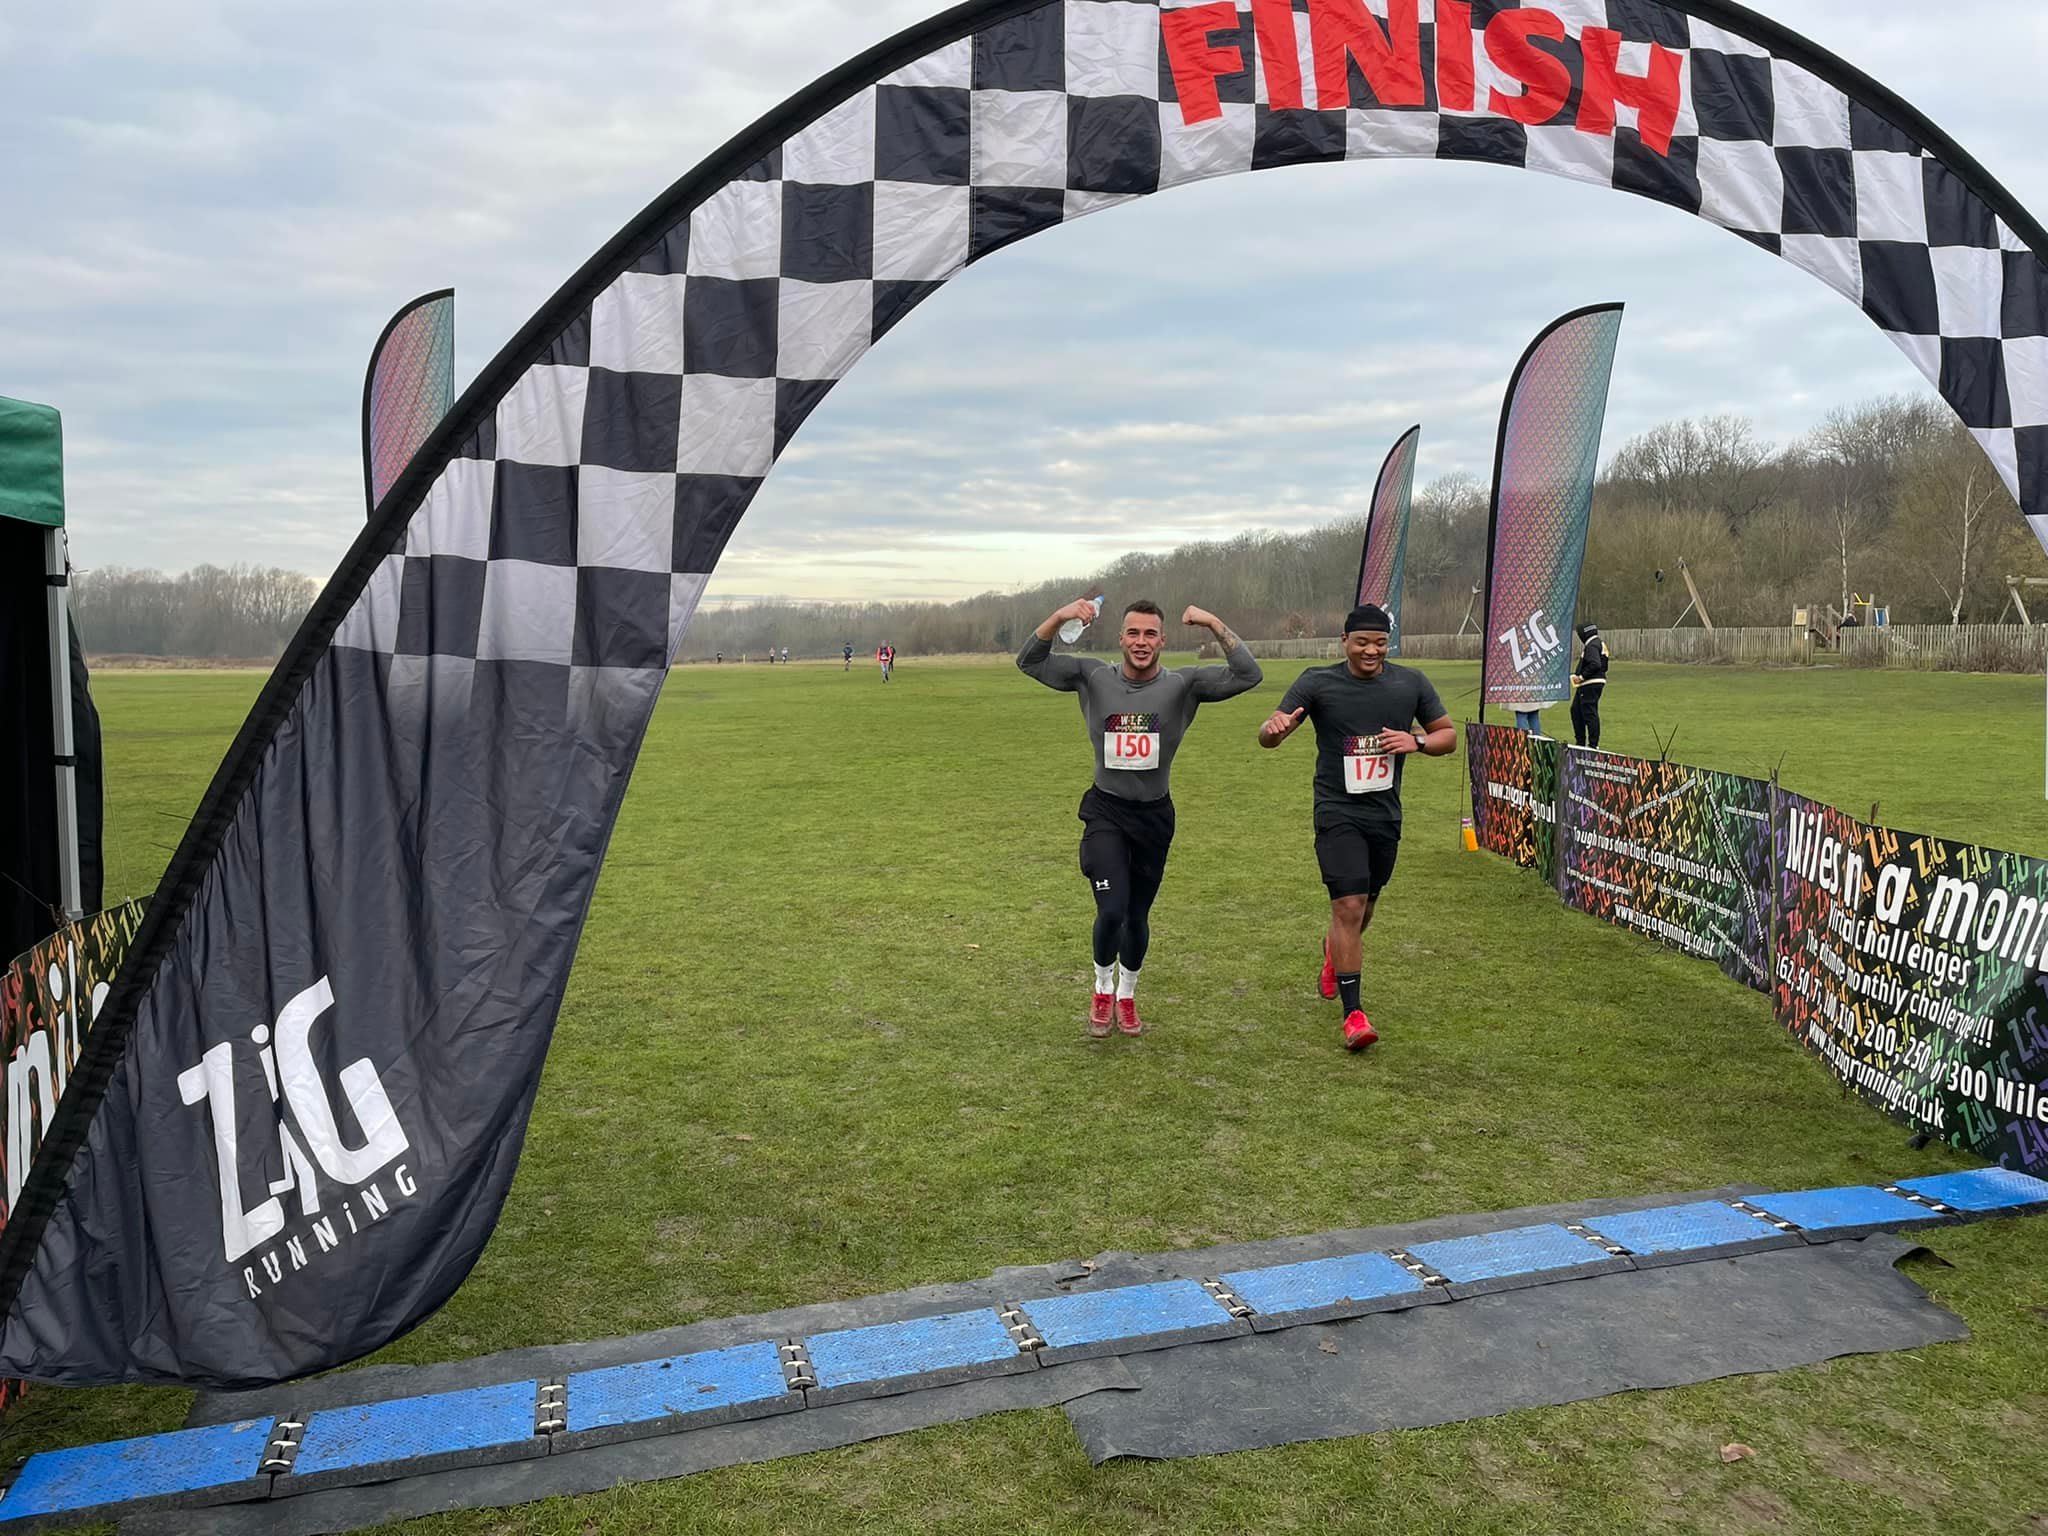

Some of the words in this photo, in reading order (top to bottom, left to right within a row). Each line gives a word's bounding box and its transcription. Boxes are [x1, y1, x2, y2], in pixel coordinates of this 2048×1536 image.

[1160, 0, 1683, 157] FINISH
[1116, 734, 1151, 758] 150
[1355, 756, 1389, 780] 175
[1650, 847, 1675, 873] tough
[1675, 857, 1709, 881] runners
[1710, 863, 1721, 884] do
[1785, 807, 1842, 895] Miles
[1844, 831, 1863, 911] n
[1876, 863, 1912, 925] a
[1923, 875, 2048, 973] mont
[1614, 903, 1715, 956] www.zigzagunning.co.uk
[1828, 898, 1857, 946] Virtal
[1855, 918, 1971, 987] challenges
[1847, 967, 1909, 1016] monthly
[1930, 1058, 1948, 1084] or
[1947, 1060, 1988, 1102] 300
